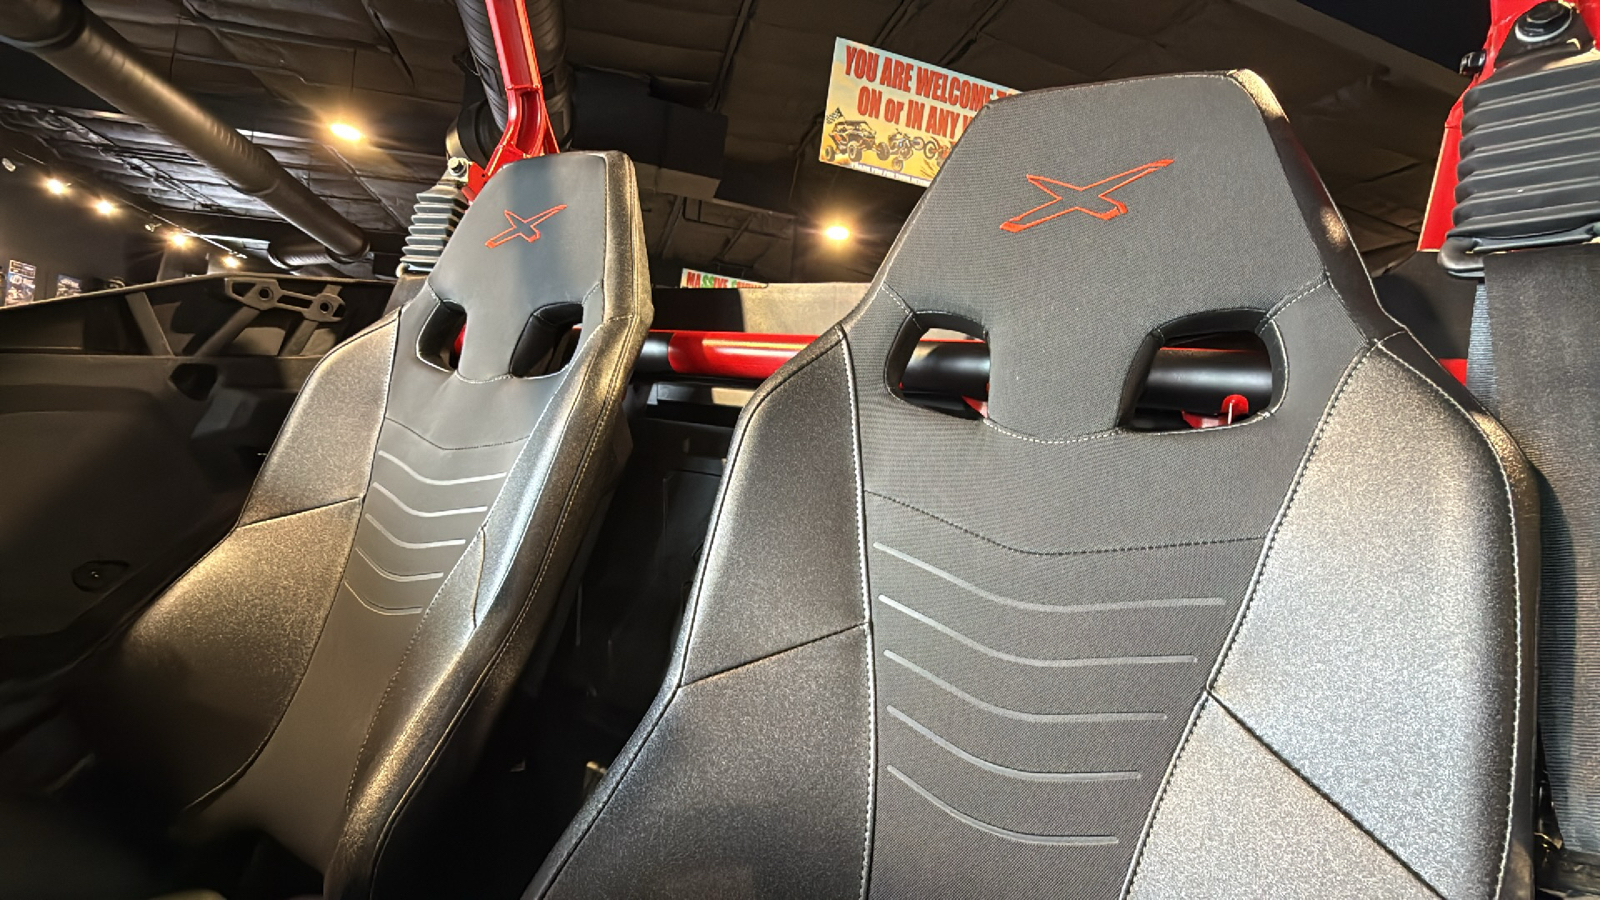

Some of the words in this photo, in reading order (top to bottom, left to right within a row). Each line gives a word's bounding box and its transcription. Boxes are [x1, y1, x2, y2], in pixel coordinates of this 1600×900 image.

[845, 45, 880, 83] YOU
[880, 57, 914, 93] ARE
[857, 86, 883, 119] ON
[884, 98, 905, 125] or
[905, 99, 925, 131] IN
[925, 106, 961, 140] ANY
[687, 271, 729, 288] MASSIVE
